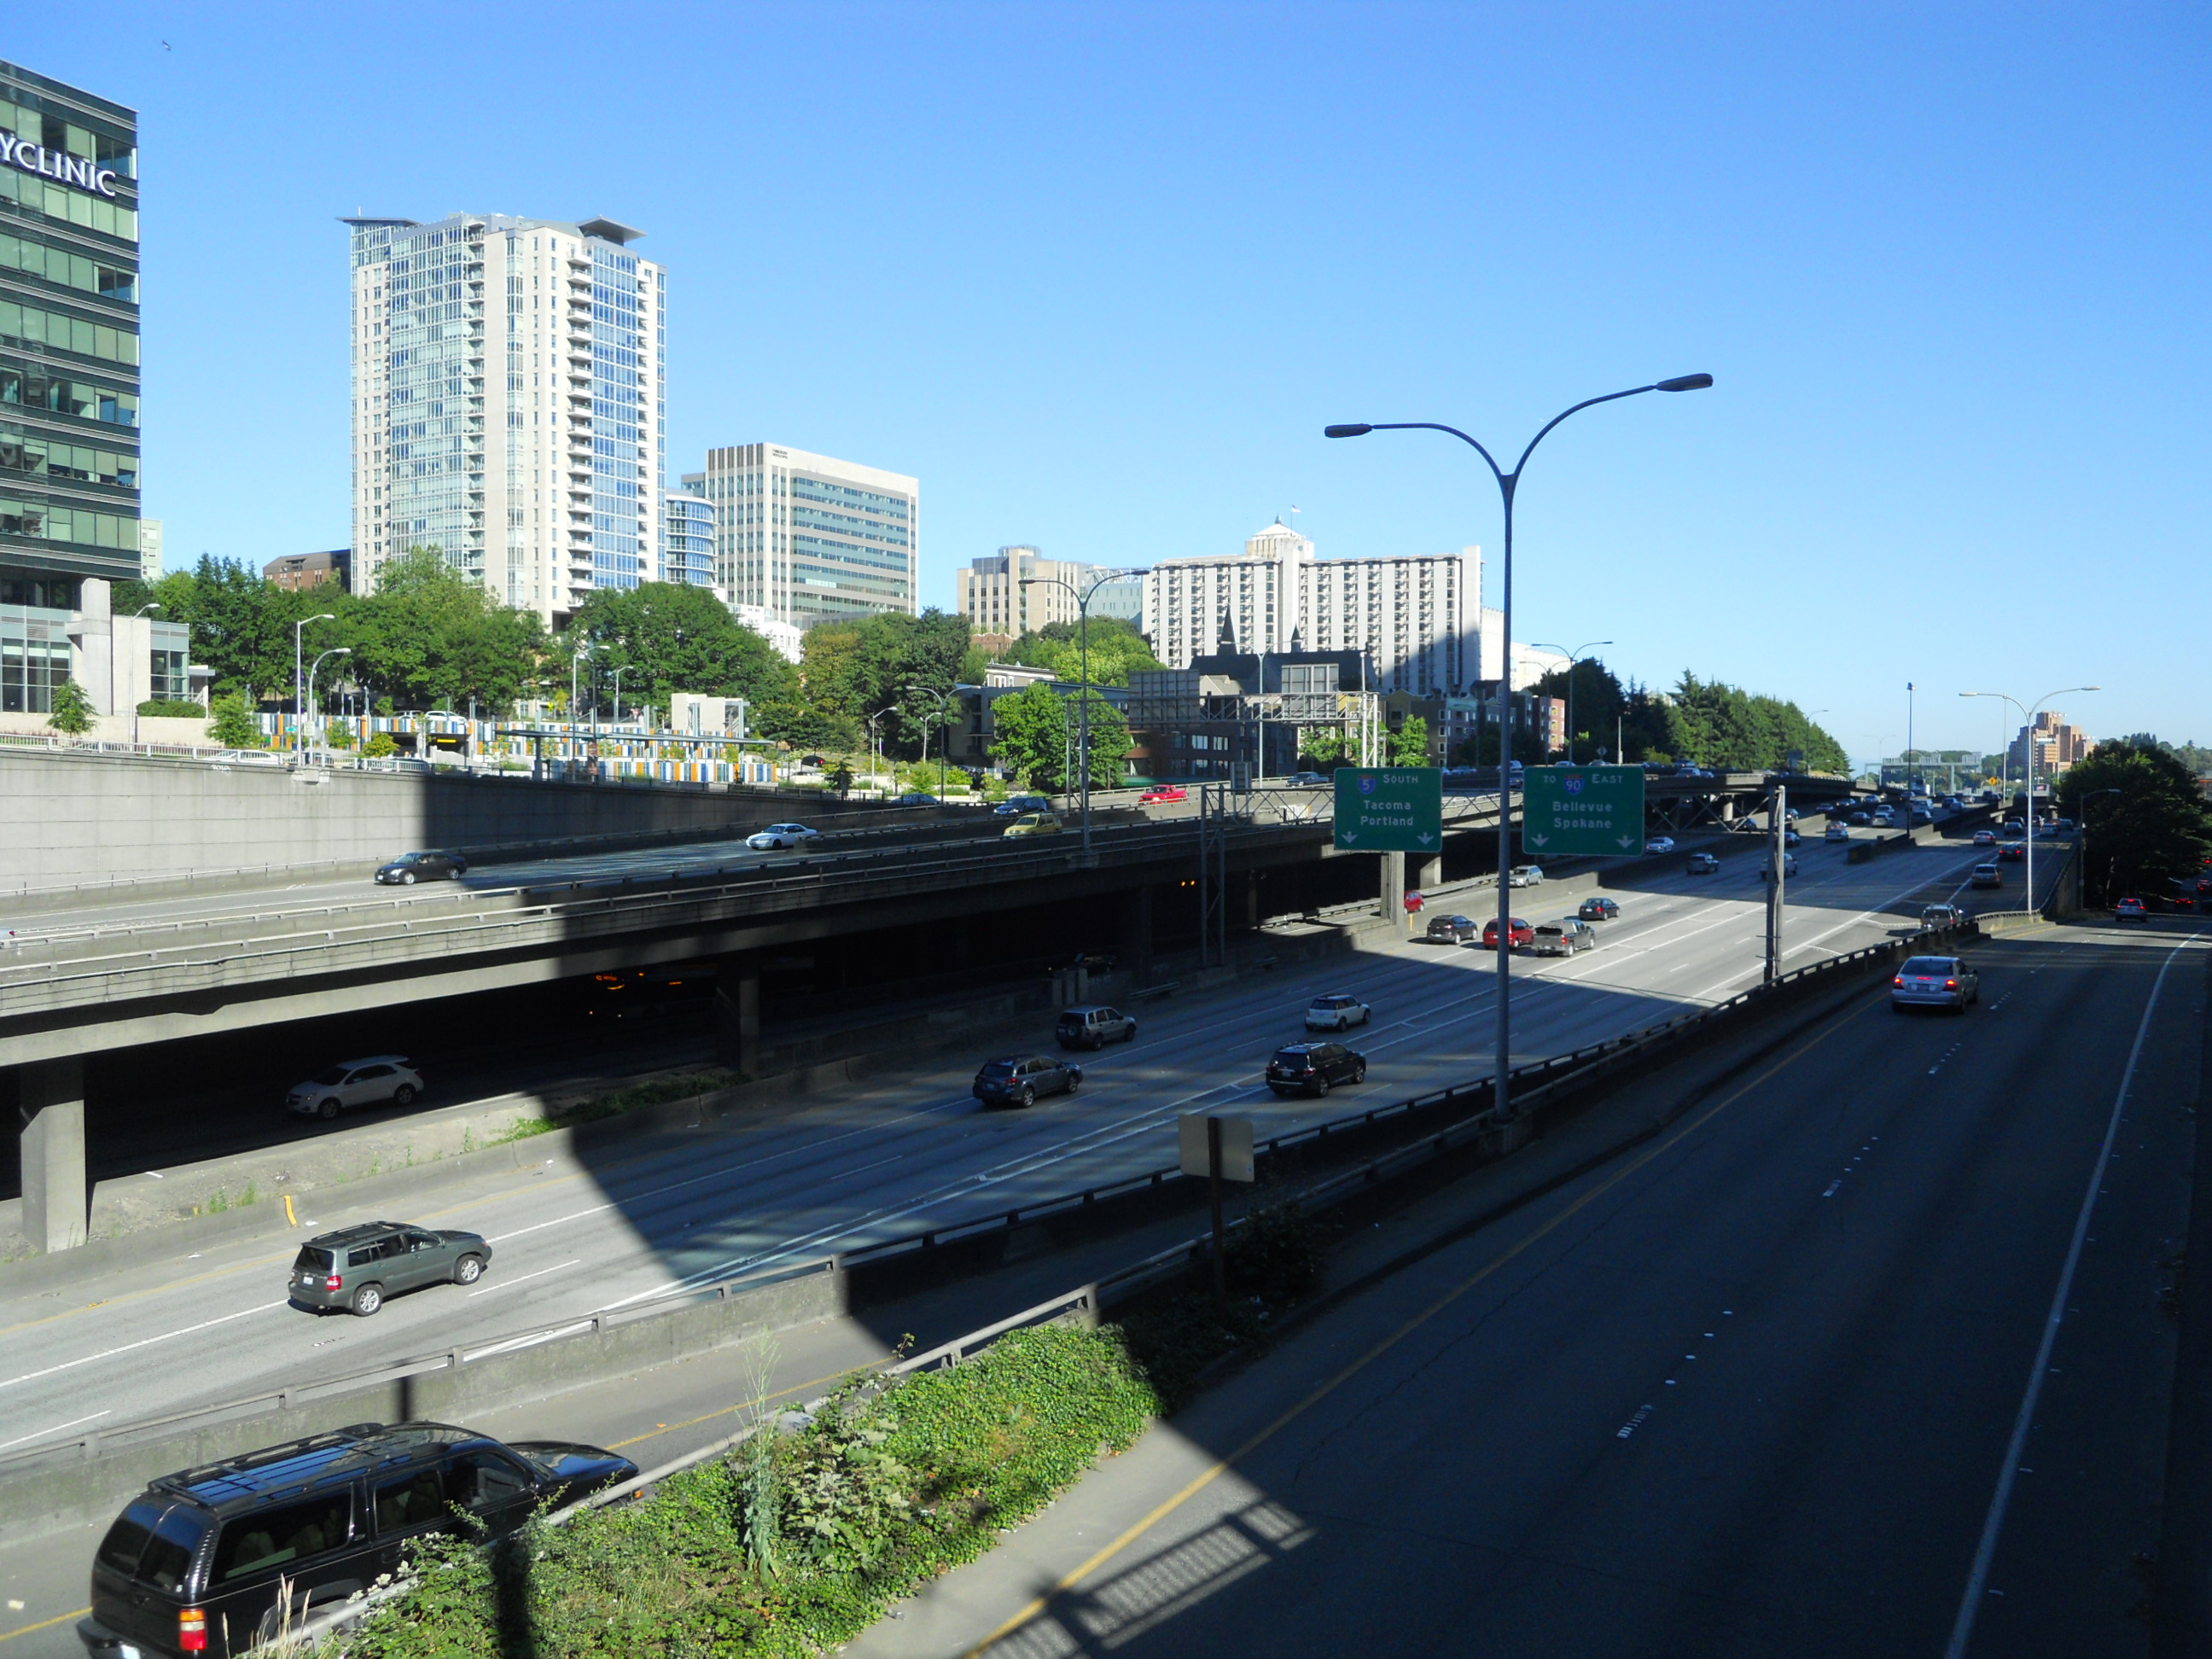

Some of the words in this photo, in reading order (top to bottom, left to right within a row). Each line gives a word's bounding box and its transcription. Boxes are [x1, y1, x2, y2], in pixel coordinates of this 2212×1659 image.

[1362, 779, 1370, 791] 5
[1382, 773, 1418, 783] SOUTH
[1543, 775, 1557, 783] TO
[1565, 780, 1581, 790] 90
[1592, 773, 1623, 783] EAST
[1364, 800, 1412, 810] Tacoma
[1552, 800, 1612, 812] Bellevue
[1360, 815, 1414, 826] Portland
[1553, 818, 1612, 830] Spokane
